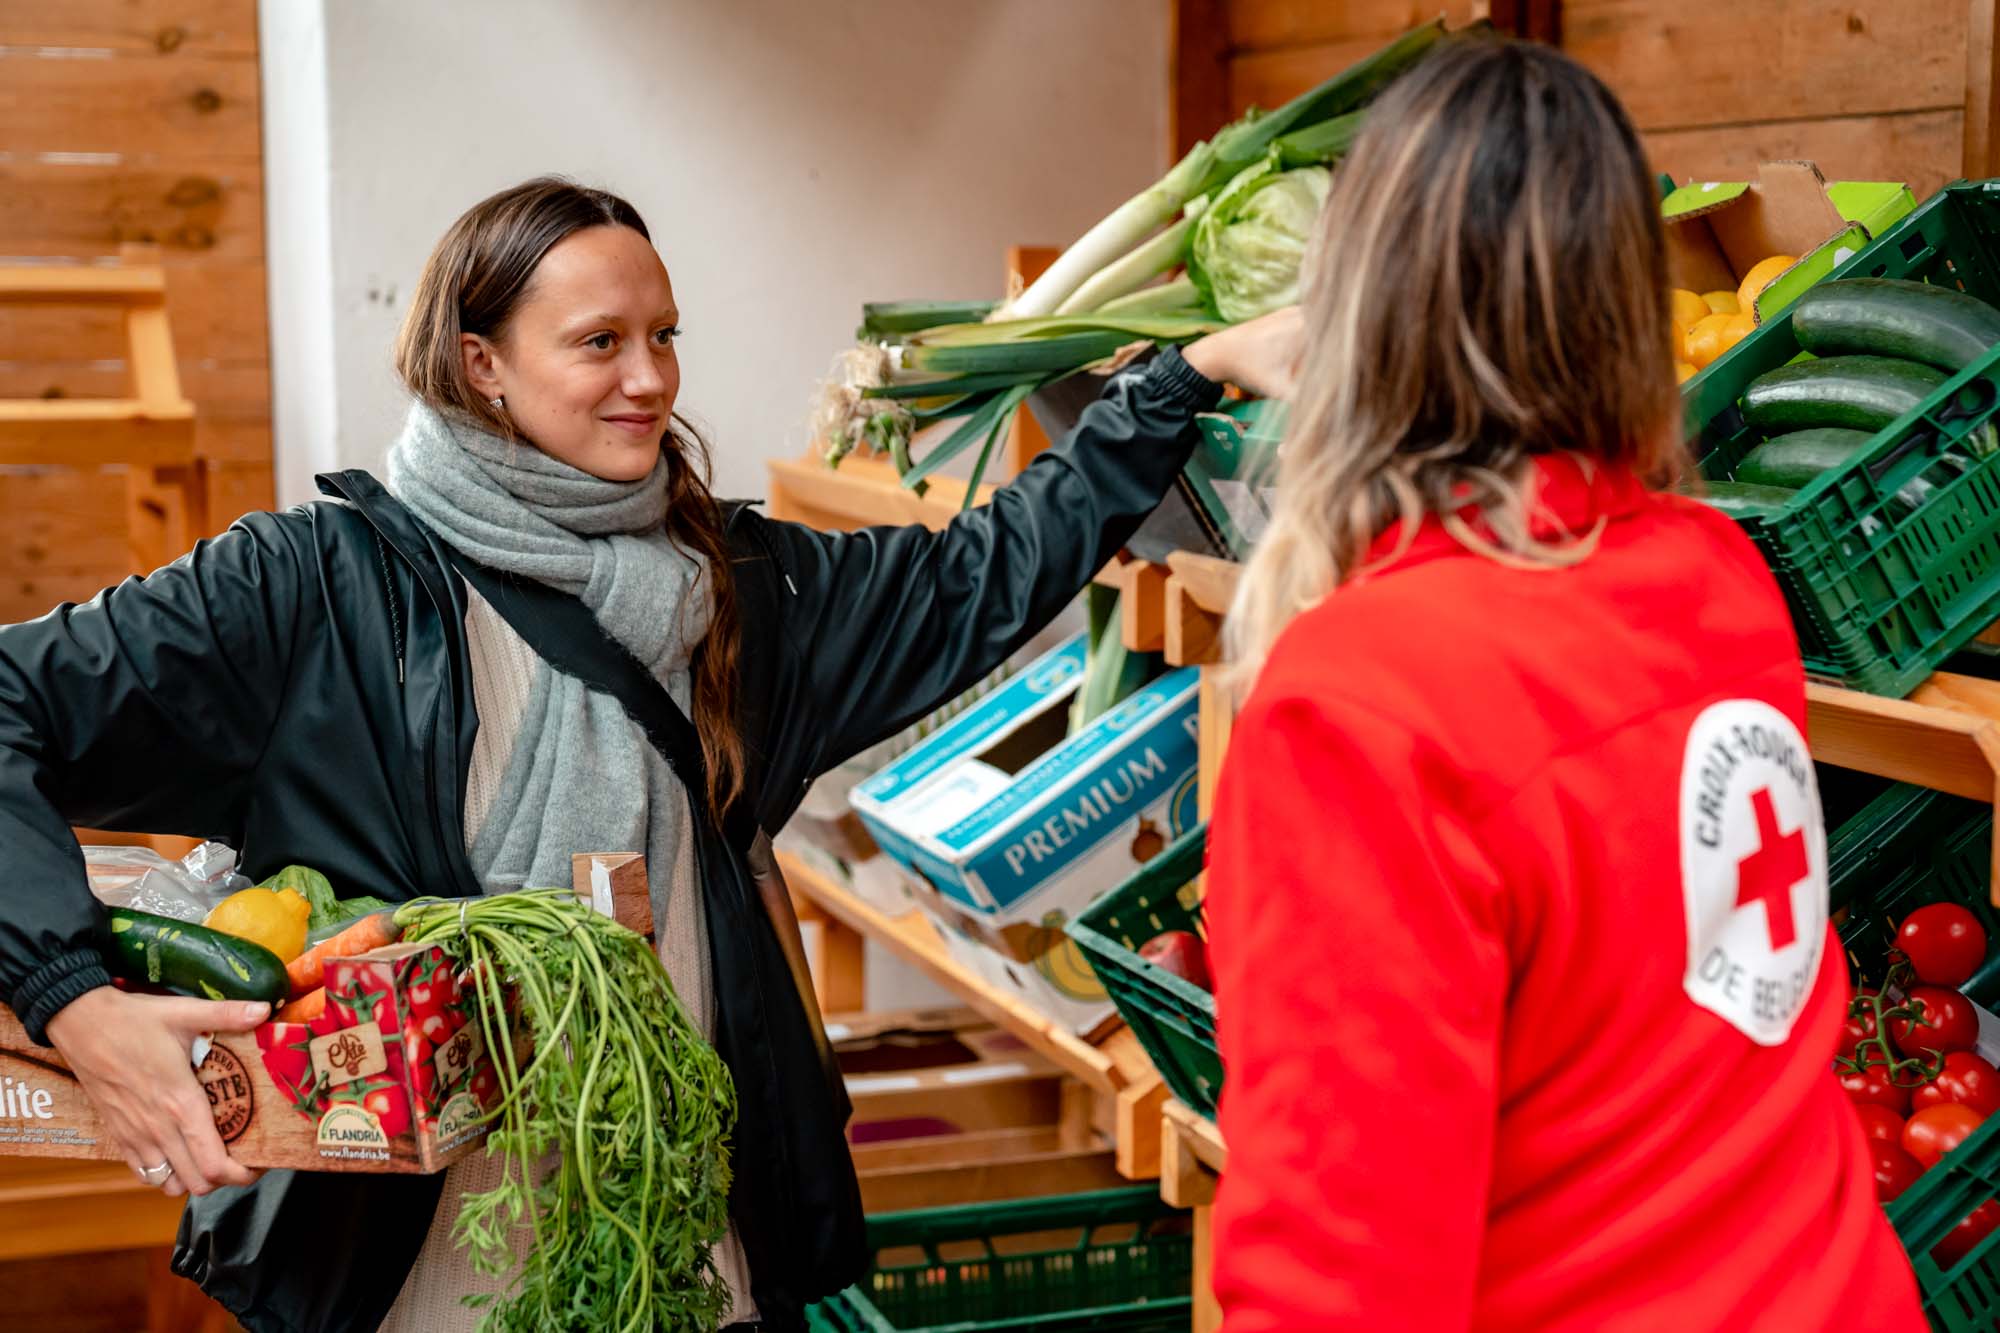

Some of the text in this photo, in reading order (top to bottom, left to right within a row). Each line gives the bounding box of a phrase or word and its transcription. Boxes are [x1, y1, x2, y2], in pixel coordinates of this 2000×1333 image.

[1004, 747, 1167, 876] PREMIUM
[1698, 946, 1746, 1003] DE
[319, 1145, 391, 1161] www.flandria.be
[329, 1128, 383, 1142] FLANDRIA
